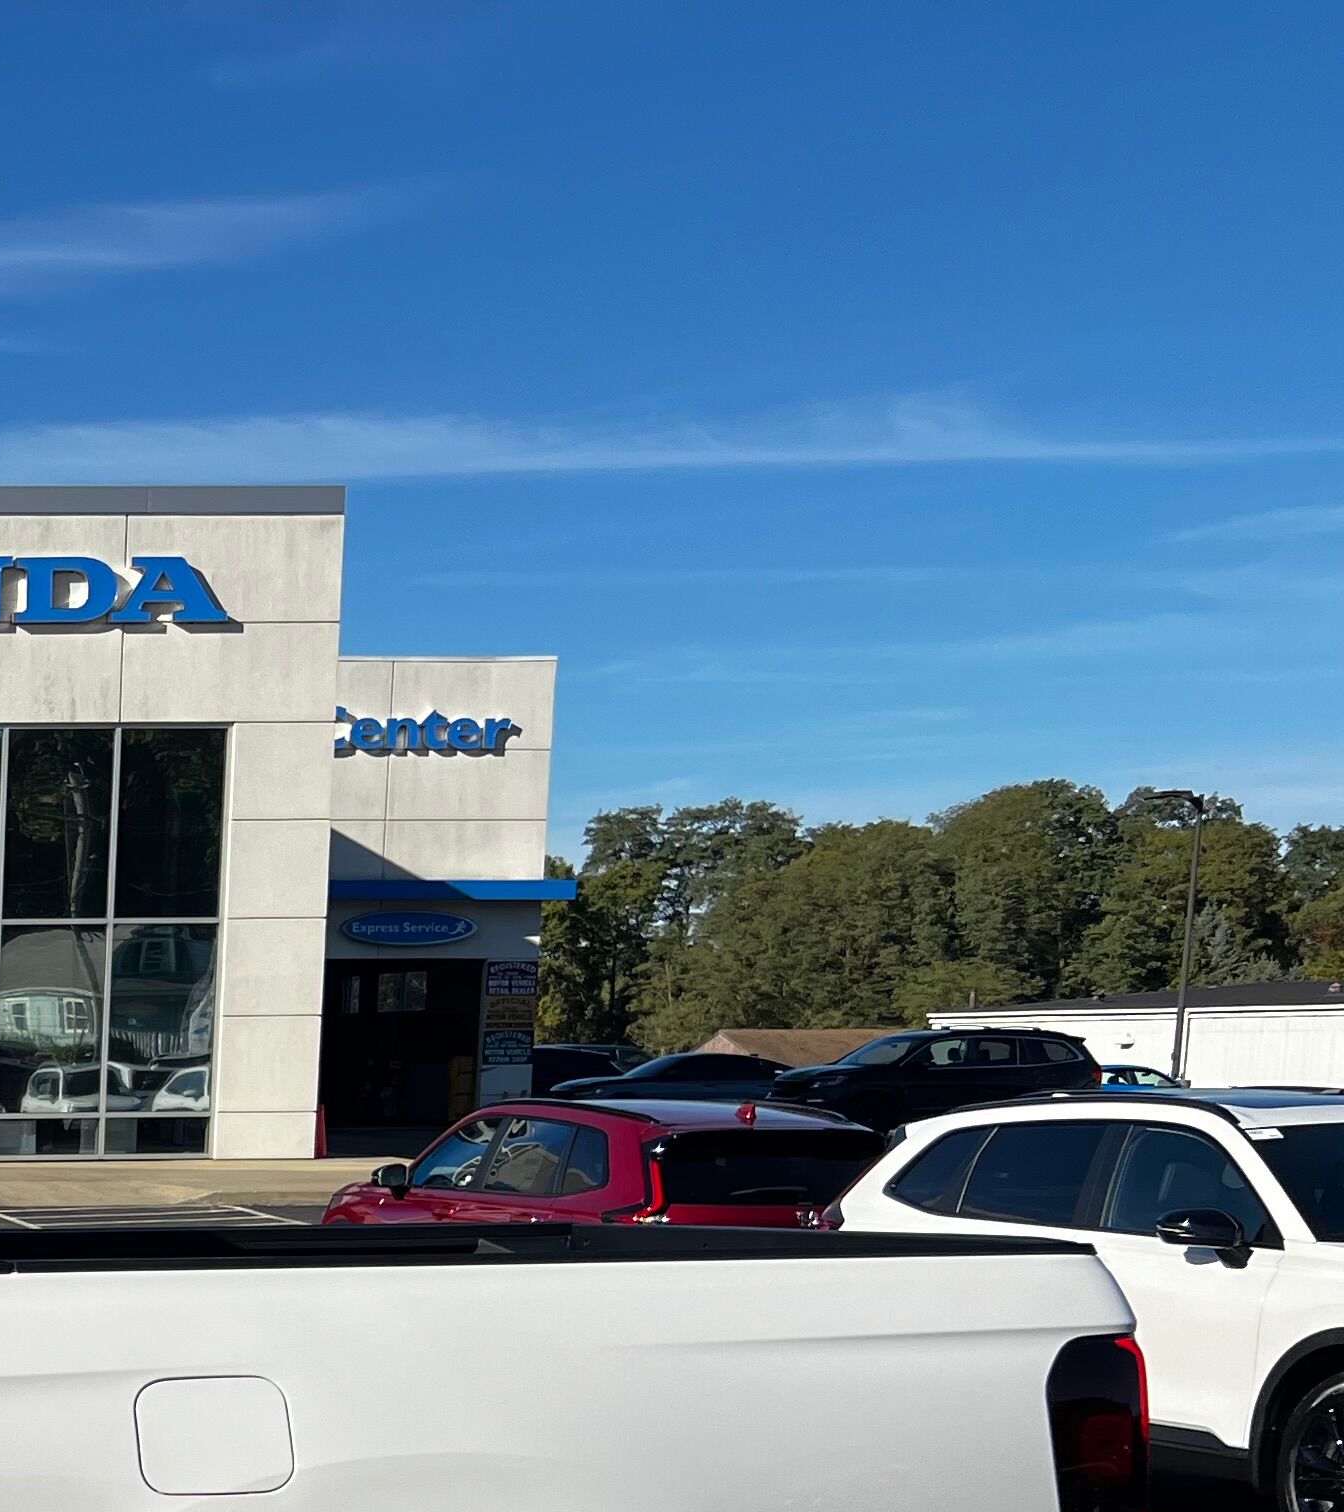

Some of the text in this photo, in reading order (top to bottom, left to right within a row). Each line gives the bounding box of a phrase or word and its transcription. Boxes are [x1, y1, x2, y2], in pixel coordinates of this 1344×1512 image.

[352, 921, 449, 935] Express Service
[490, 962, 537, 974] REGISTERED
[486, 1031, 532, 1044] REGISTERED
